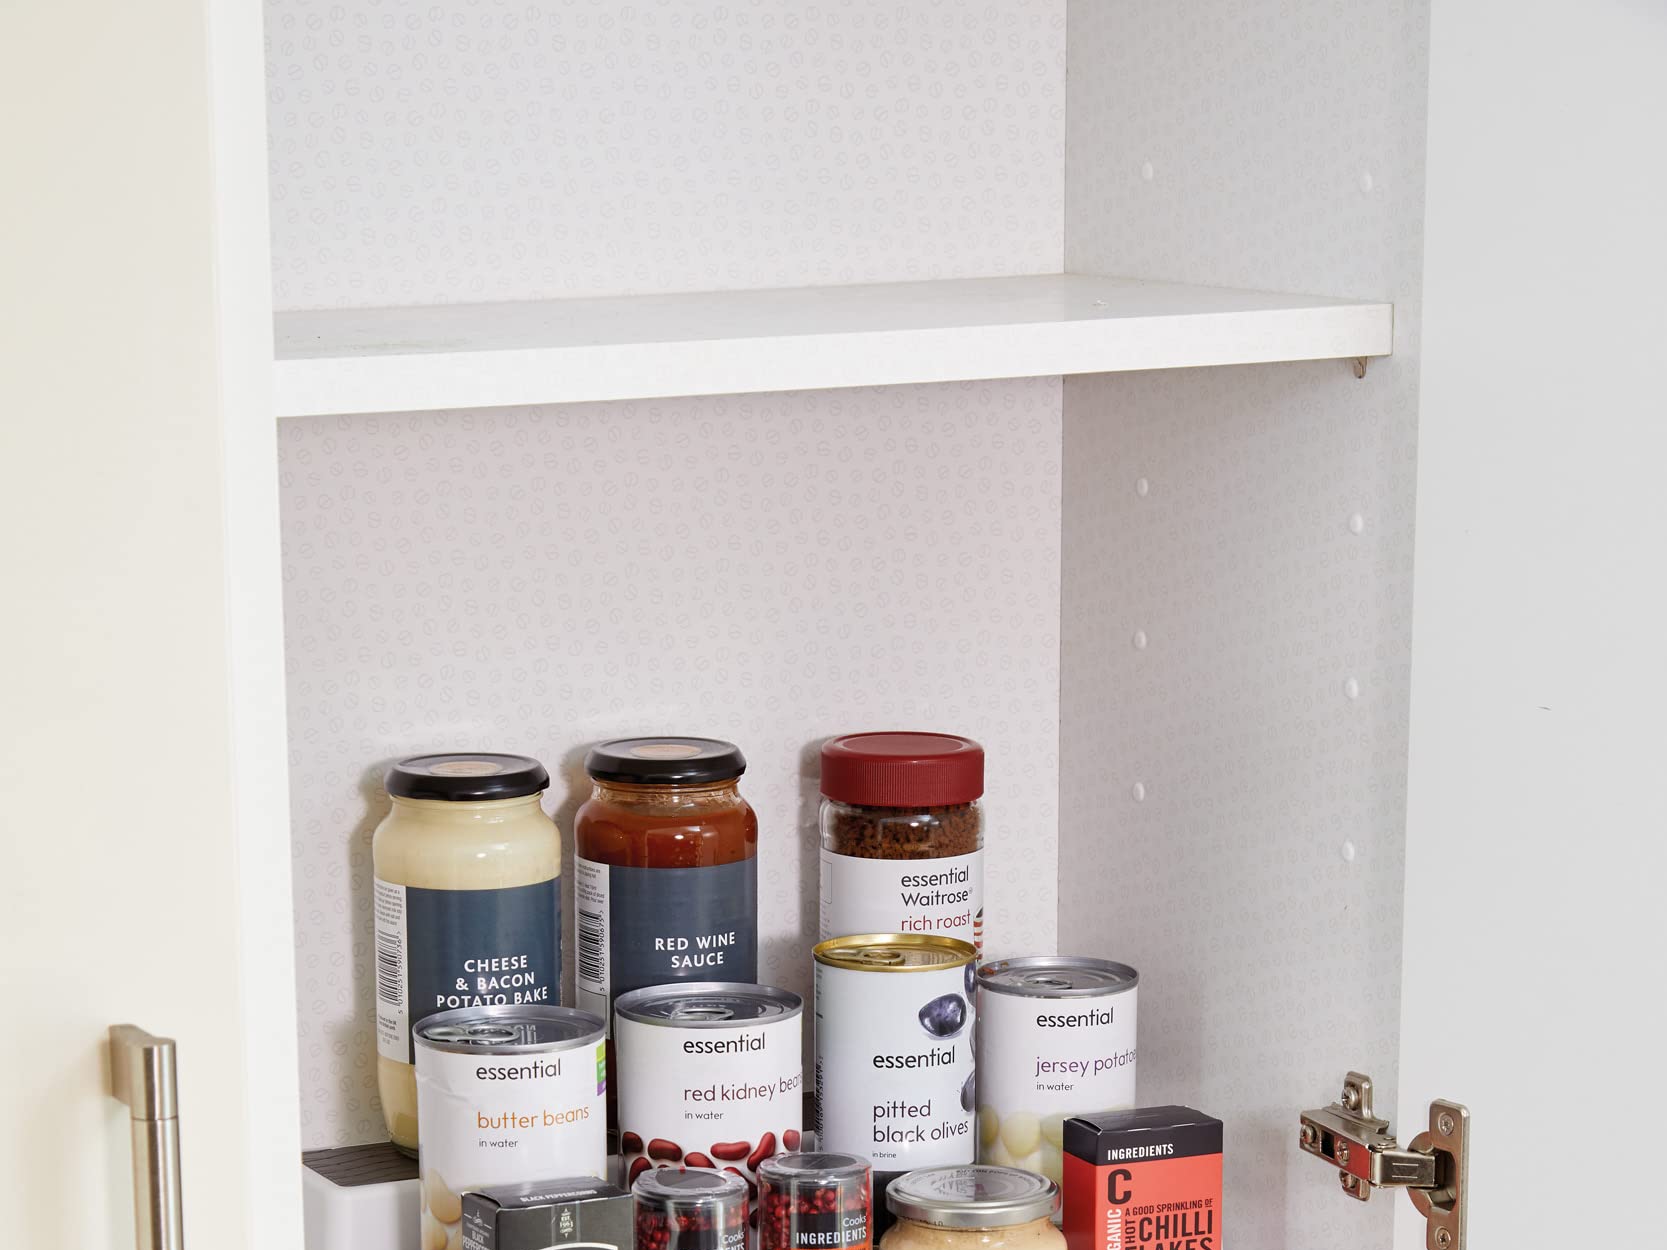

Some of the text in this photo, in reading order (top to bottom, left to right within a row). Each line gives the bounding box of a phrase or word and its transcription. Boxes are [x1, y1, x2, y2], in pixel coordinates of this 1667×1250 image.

[901, 864, 969, 888] essential
[901, 909, 971, 931] rich roast
[655, 931, 736, 951] RED WINE
[464, 954, 528, 973] CHEESE
[671, 951, 724, 968] SAUCE
[455, 971, 535, 991] & BACON
[436, 986, 548, 1008] POTATO BAKE
[1036, 1006, 1114, 1028] essential
[683, 1032, 765, 1054] essential
[873, 1045, 955, 1069] essential
[1035, 1056, 1090, 1078] jersey
[476, 1058, 561, 1080] essential
[684, 1084, 716, 1102] red
[721, 1082, 776, 1102] kidney
[1036, 1081, 1074, 1091] in water
[477, 1106, 589, 1129] butter beans
[685, 1110, 724, 1120] in water
[873, 1099, 931, 1123] pitted
[479, 1137, 518, 1148] in water
[873, 1120, 969, 1143] black olives
[1107, 1143, 1174, 1161] INGREDIENTS
[1107, 1168, 1132, 1205] C
[1125, 1198, 1213, 1217] A GOOD SPRINKLING OF
[796, 1226, 867, 1245] INGREDIENTS
[1124, 1209, 1213, 1244] HOT CHILLI
